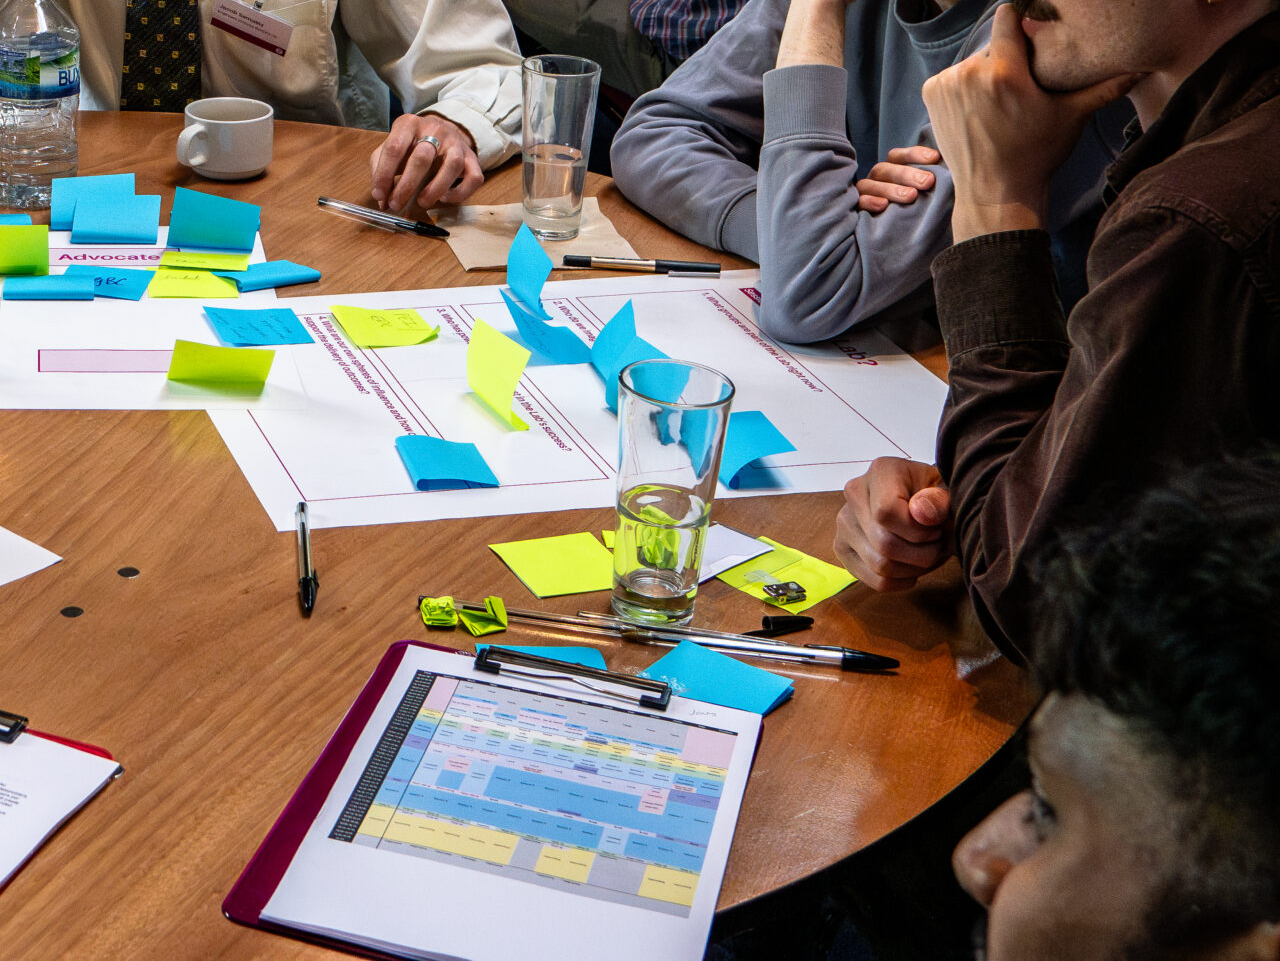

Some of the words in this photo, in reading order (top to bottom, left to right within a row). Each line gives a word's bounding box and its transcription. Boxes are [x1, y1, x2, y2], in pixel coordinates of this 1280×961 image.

[58, 252, 161, 263] Advocate
[558, 306, 572, 316] Who
[321, 320, 336, 334] What
[331, 333, 341, 341] are
[337, 341, 348, 350] our
[706, 296, 724, 309] What
[717, 308, 742, 325] groups
[738, 324, 751, 333] are
[745, 332, 763, 343] part
[765, 347, 779, 356] the
[775, 356, 791, 366] Lab
[786, 366, 806, 379] right
[800, 378, 823, 392] now?
[304, 316, 324, 335] support
[318, 335, 329, 343] the
[324, 343, 344, 362] delivery
[342, 367, 370, 395] outcomes?
[344, 350, 357, 360] own
[351, 360, 372, 379] spheres
[441, 314, 455, 325] Who
[450, 324, 463, 333] has
[521, 402, 533, 411] the
[529, 412, 548, 427] Lab's
[542, 427, 572, 451] success?
[370, 385, 395, 410] influence
[389, 409, 407, 420] and
[397, 420, 414, 432] how
